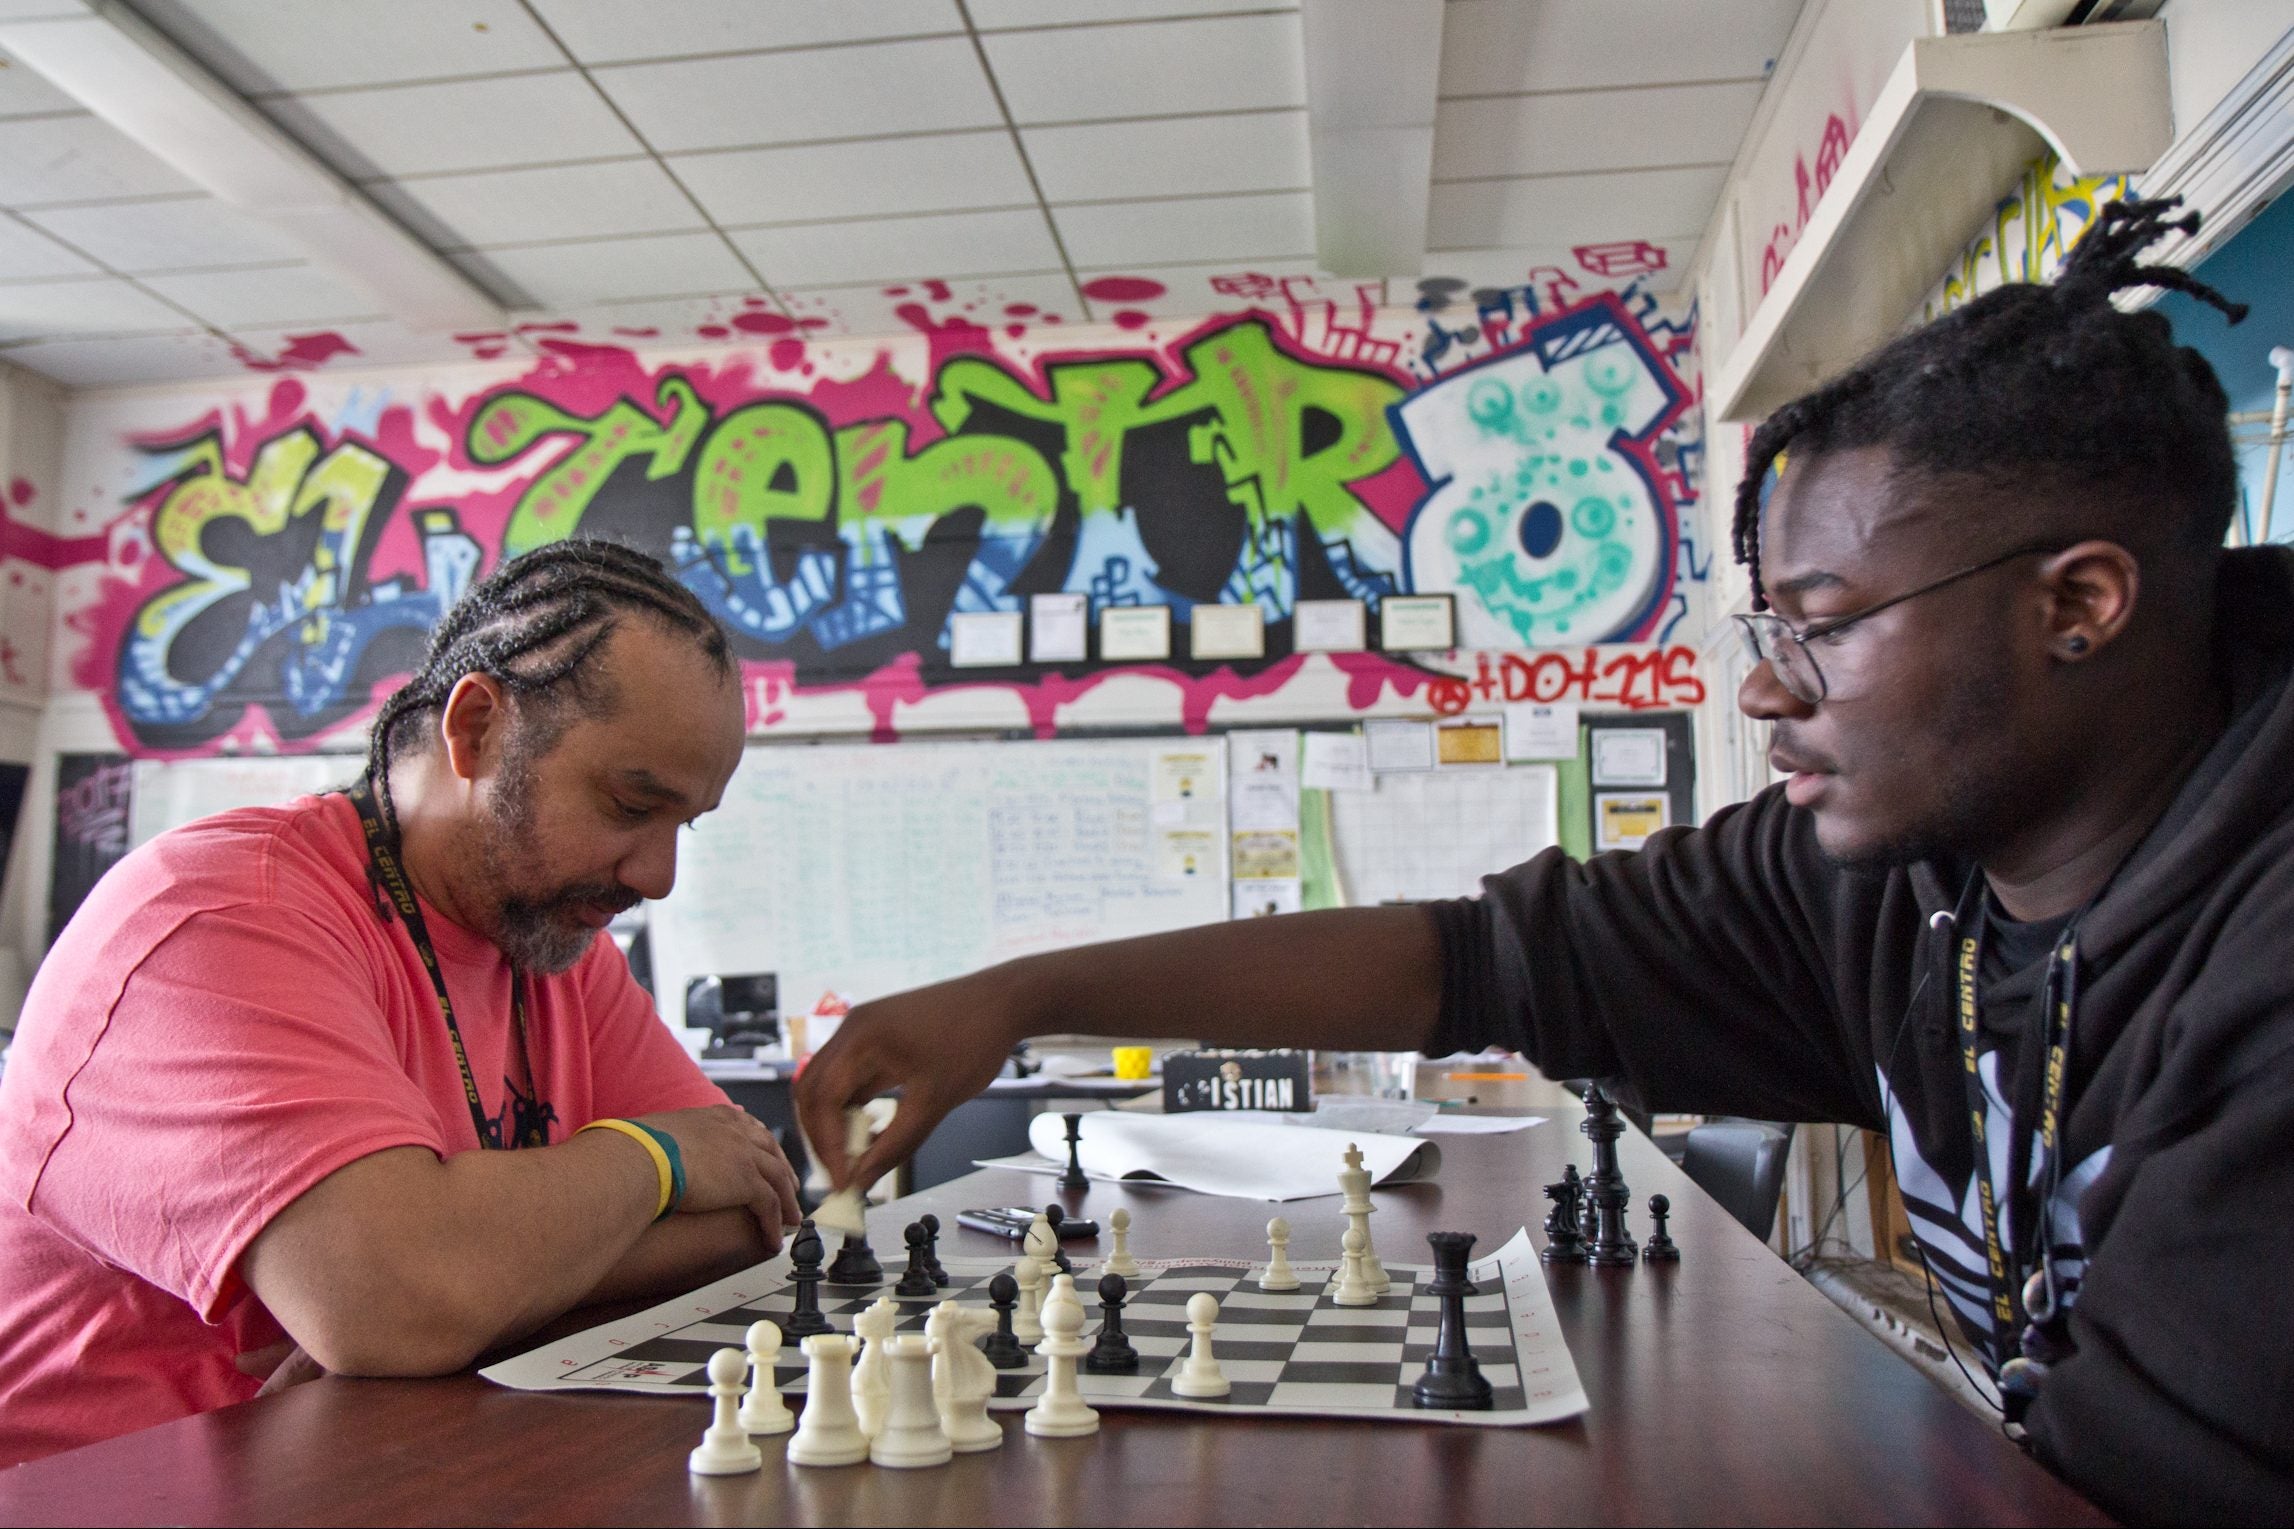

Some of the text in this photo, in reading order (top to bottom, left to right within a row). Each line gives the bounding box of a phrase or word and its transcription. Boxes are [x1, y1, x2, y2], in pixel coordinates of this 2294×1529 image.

[363, 817, 380, 839] EL
[1959, 937, 1977, 1074] EL CENTRO
[1979, 1179, 2004, 1279] CENTRO
